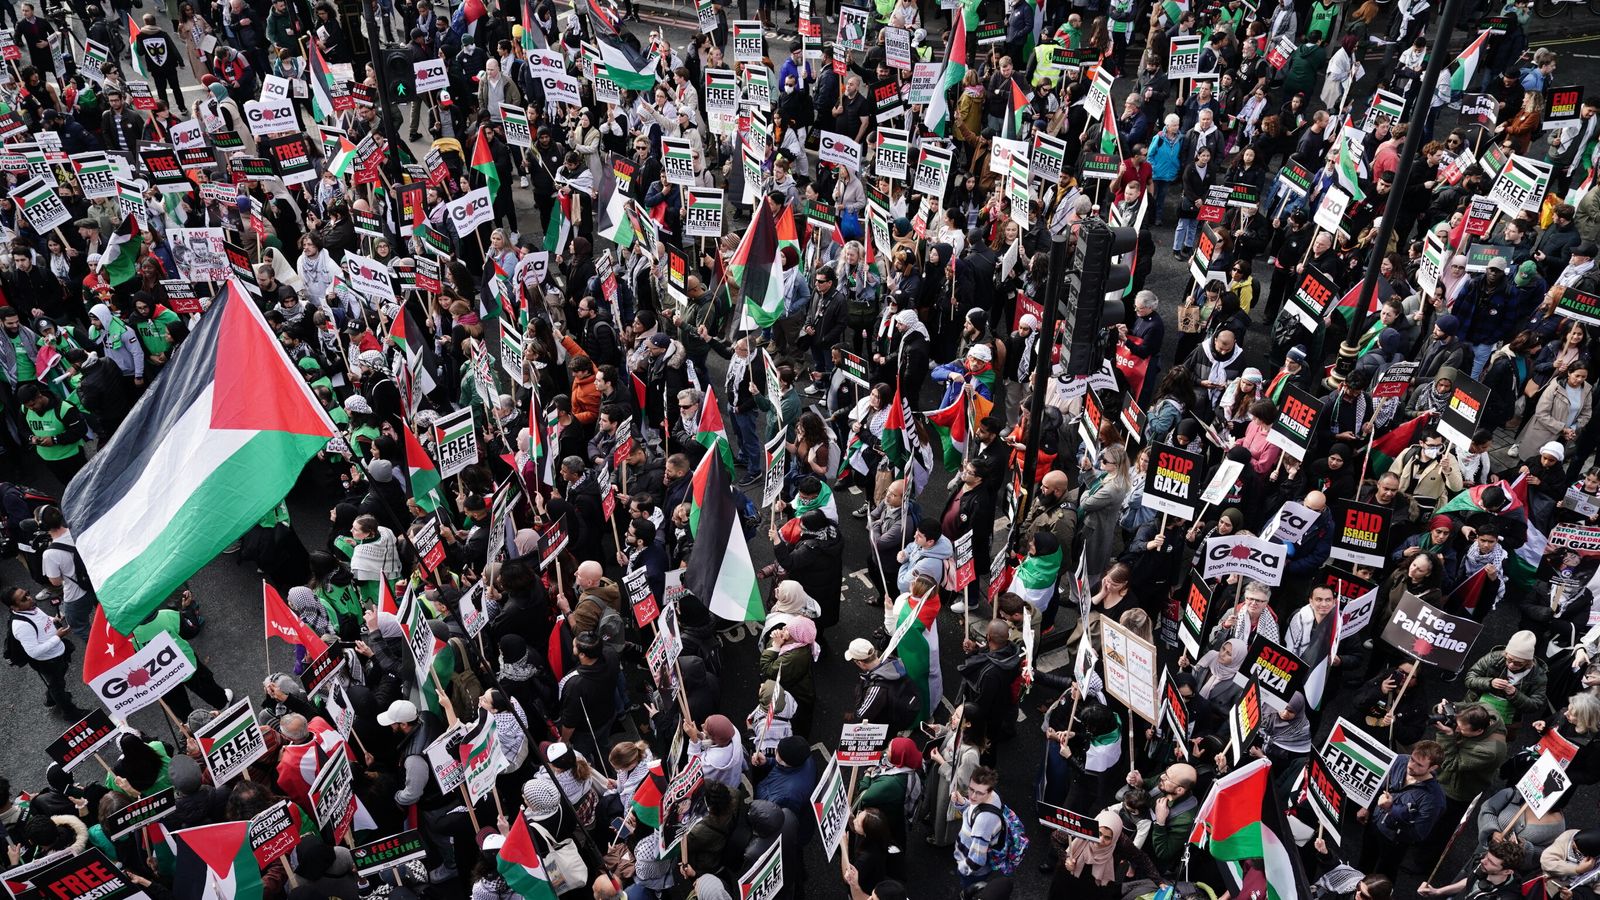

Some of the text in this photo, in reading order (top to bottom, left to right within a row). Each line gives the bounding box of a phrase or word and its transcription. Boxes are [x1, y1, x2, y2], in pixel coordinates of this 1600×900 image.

[700, 8, 714, 21] FREE
[735, 39, 761, 48] FREE
[1171, 53, 1198, 65] FREE
[596, 80, 620, 90] FREE
[707, 89, 734, 99] FREE
[749, 84, 769, 97] FREE
[875, 82, 897, 100] FREE
[1089, 86, 1106, 106] FREE
[1553, 92, 1578, 105] END
[1552, 105, 1575, 113] ISRAELI
[504, 121, 529, 134] FREE
[750, 122, 765, 147] FREE
[276, 142, 306, 159] FREE
[878, 150, 906, 163] FREE
[1032, 151, 1062, 170] FREE
[147, 157, 177, 171] FREE
[280, 154, 308, 168] PALESTINE
[664, 159, 692, 172] FREE
[877, 160, 906, 169] PALESTINE
[1032, 160, 1060, 176] PALESTINE
[1085, 161, 1118, 171] PALESTINE
[79, 171, 114, 185] FREE
[153, 169, 182, 178] PALESTINE
[666, 168, 693, 178] PALESTINE
[918, 166, 940, 180] FRE
[82, 182, 116, 191] PALESTINE
[1497, 175, 1527, 202] FREE
[1011, 195, 1028, 212] FREE
[1493, 186, 1522, 209] PALESTINE
[24, 196, 61, 220] FREE
[32, 206, 64, 226] PALESTINE
[688, 209, 720, 221] FREE
[688, 220, 720, 228] PALESTINE
[1422, 256, 1438, 279] FREE
[1302, 274, 1332, 306] FREE
[1576, 293, 1596, 306] FREE
[1297, 288, 1324, 314] PALESTINE
[501, 344, 522, 368] FREE
[1282, 395, 1317, 426] FREE
[1459, 402, 1478, 421] ISRAEL
[30, 416, 43, 430] FOA
[1278, 414, 1309, 437] PALESTINE
[440, 432, 476, 458] FREE
[441, 446, 476, 467] PALESTINE
[1158, 452, 1193, 473] STOP
[1157, 467, 1191, 484] BOMBING
[1154, 477, 1189, 498] GAZA
[1280, 511, 1306, 530] za
[1346, 509, 1382, 532] END
[1342, 536, 1376, 548] APARTHEID
[1344, 528, 1378, 541] ISRAELI
[1210, 545, 1280, 570] Gza
[1240, 562, 1276, 578] massacre
[1326, 576, 1368, 597] FREE
[1188, 589, 1207, 621] FREE
[1418, 605, 1456, 634] Free
[412, 614, 426, 658] FREE
[1393, 614, 1468, 654] Palestine
[314, 657, 332, 677] GAZA
[1260, 646, 1298, 672] STOP
[101, 646, 178, 700] Gza
[1255, 657, 1292, 682] BOMBING
[114, 696, 134, 711] Stop
[135, 689, 149, 700] the
[150, 663, 185, 692] massacre
[1251, 667, 1288, 694] GAZA
[1167, 691, 1186, 734] FREE
[63, 720, 88, 740] STOP
[69, 727, 94, 748] GAZA
[64, 725, 110, 762] GENOCIDE
[209, 722, 261, 768] FREE
[212, 738, 262, 777] PALESTINE
[1323, 746, 1382, 787] FREE
[1312, 761, 1341, 811] FREE
[118, 798, 167, 824] BOMBING
[821, 782, 847, 837] FREE
[251, 810, 285, 836] FREEDOM
[1057, 814, 1081, 827] GAZA
[253, 818, 291, 848] PALESTINE
[356, 839, 421, 865] PALESTINE
[372, 839, 400, 853] FREE
[48, 861, 115, 900] FREE
